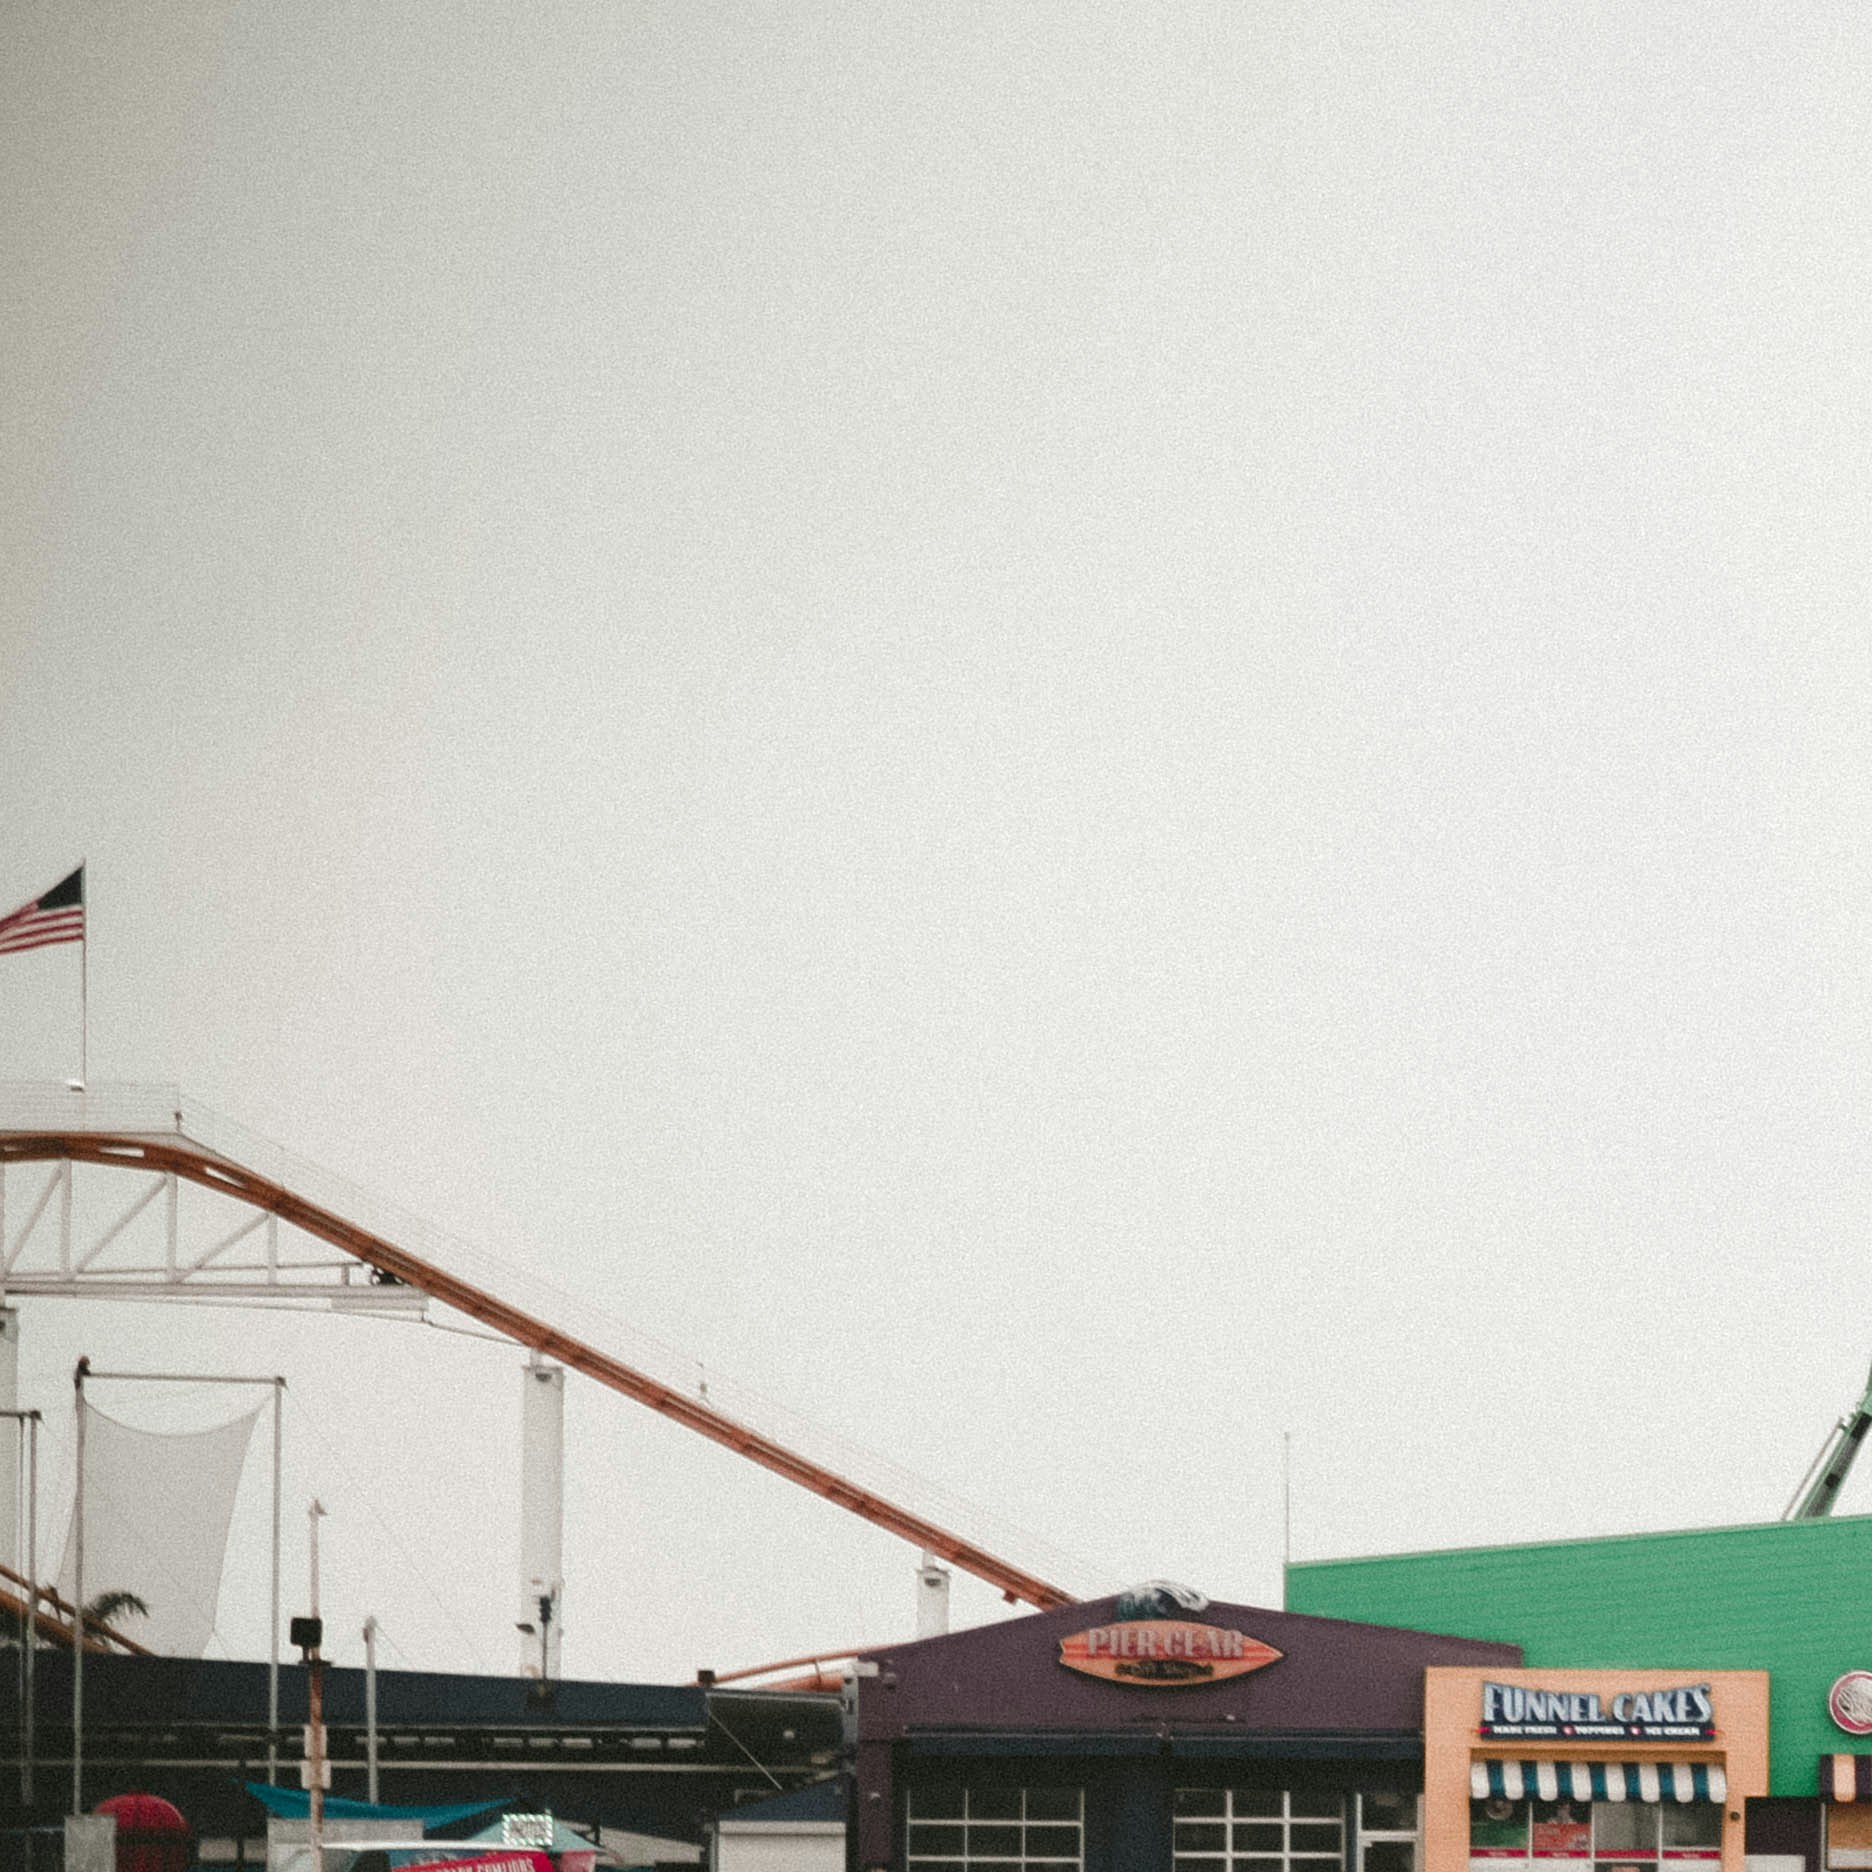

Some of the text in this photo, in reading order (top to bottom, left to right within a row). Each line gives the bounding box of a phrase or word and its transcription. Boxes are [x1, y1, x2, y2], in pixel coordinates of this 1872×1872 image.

[1088, 1628, 1244, 1657] PIER GEAR
[1482, 1680, 1714, 1723] FUNNEL CAKES
